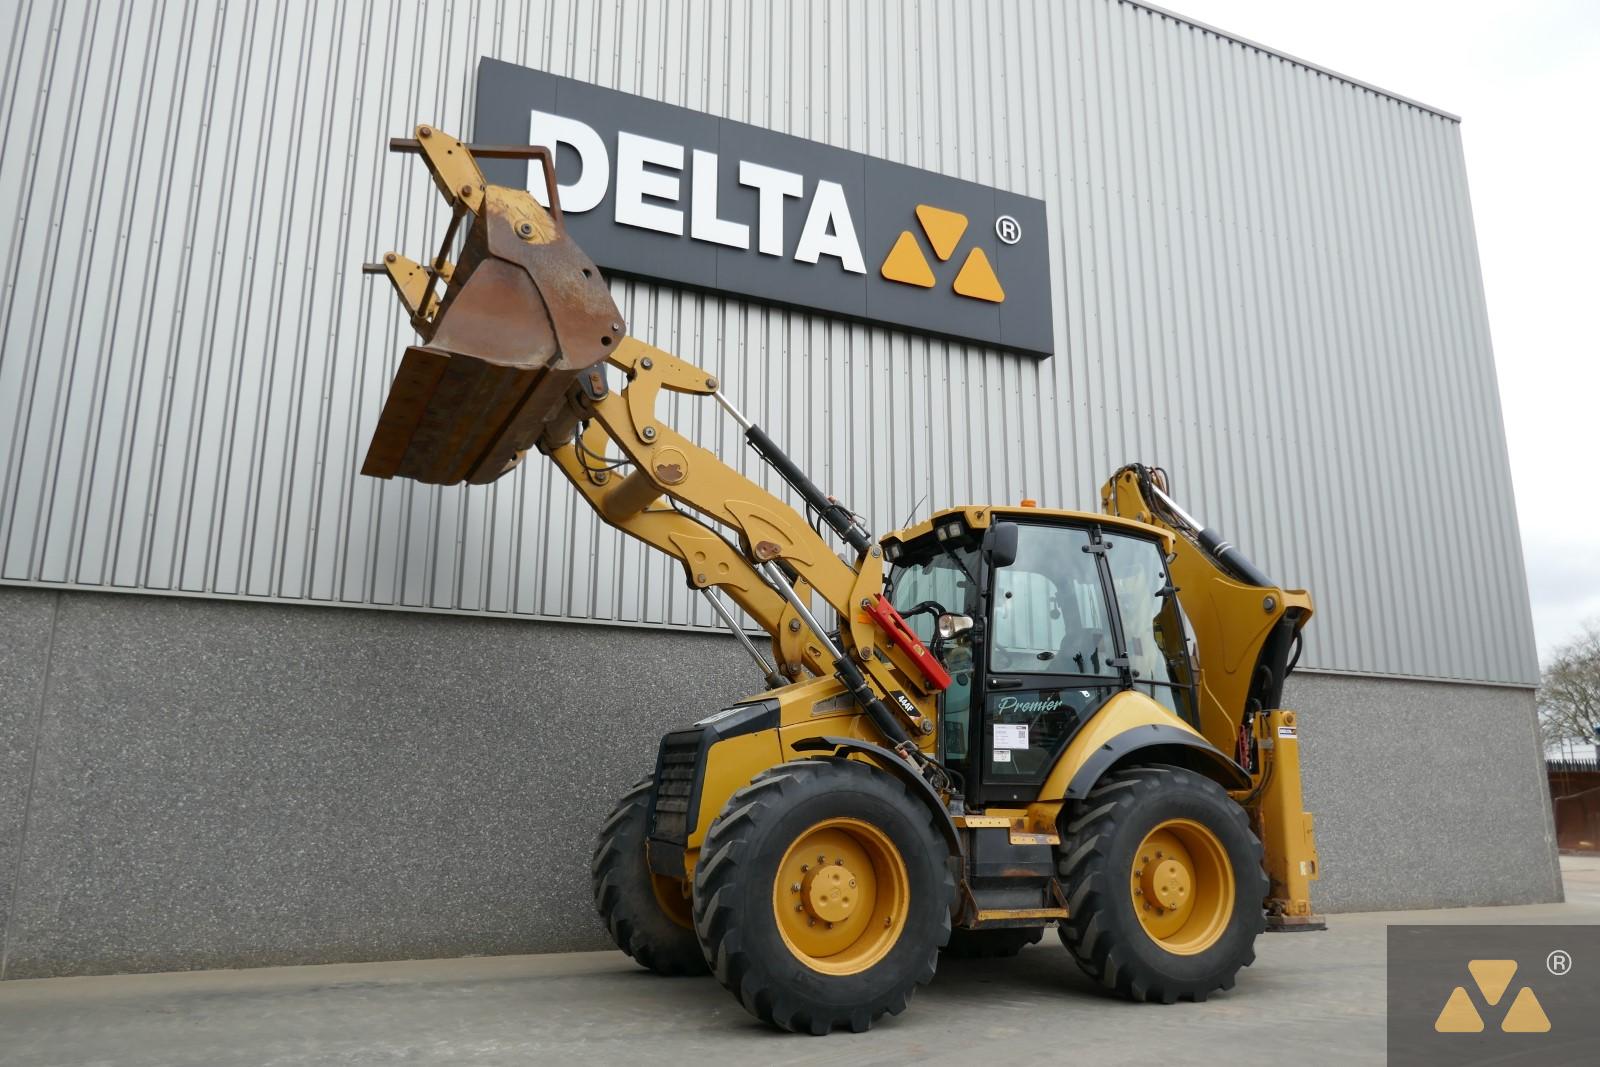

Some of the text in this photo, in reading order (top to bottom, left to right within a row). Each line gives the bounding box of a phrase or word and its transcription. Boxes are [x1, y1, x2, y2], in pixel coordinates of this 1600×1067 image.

[525, 109, 867, 275] DELTA
[898, 695, 914, 712] 444F
[998, 696, 1063, 715] Premier
